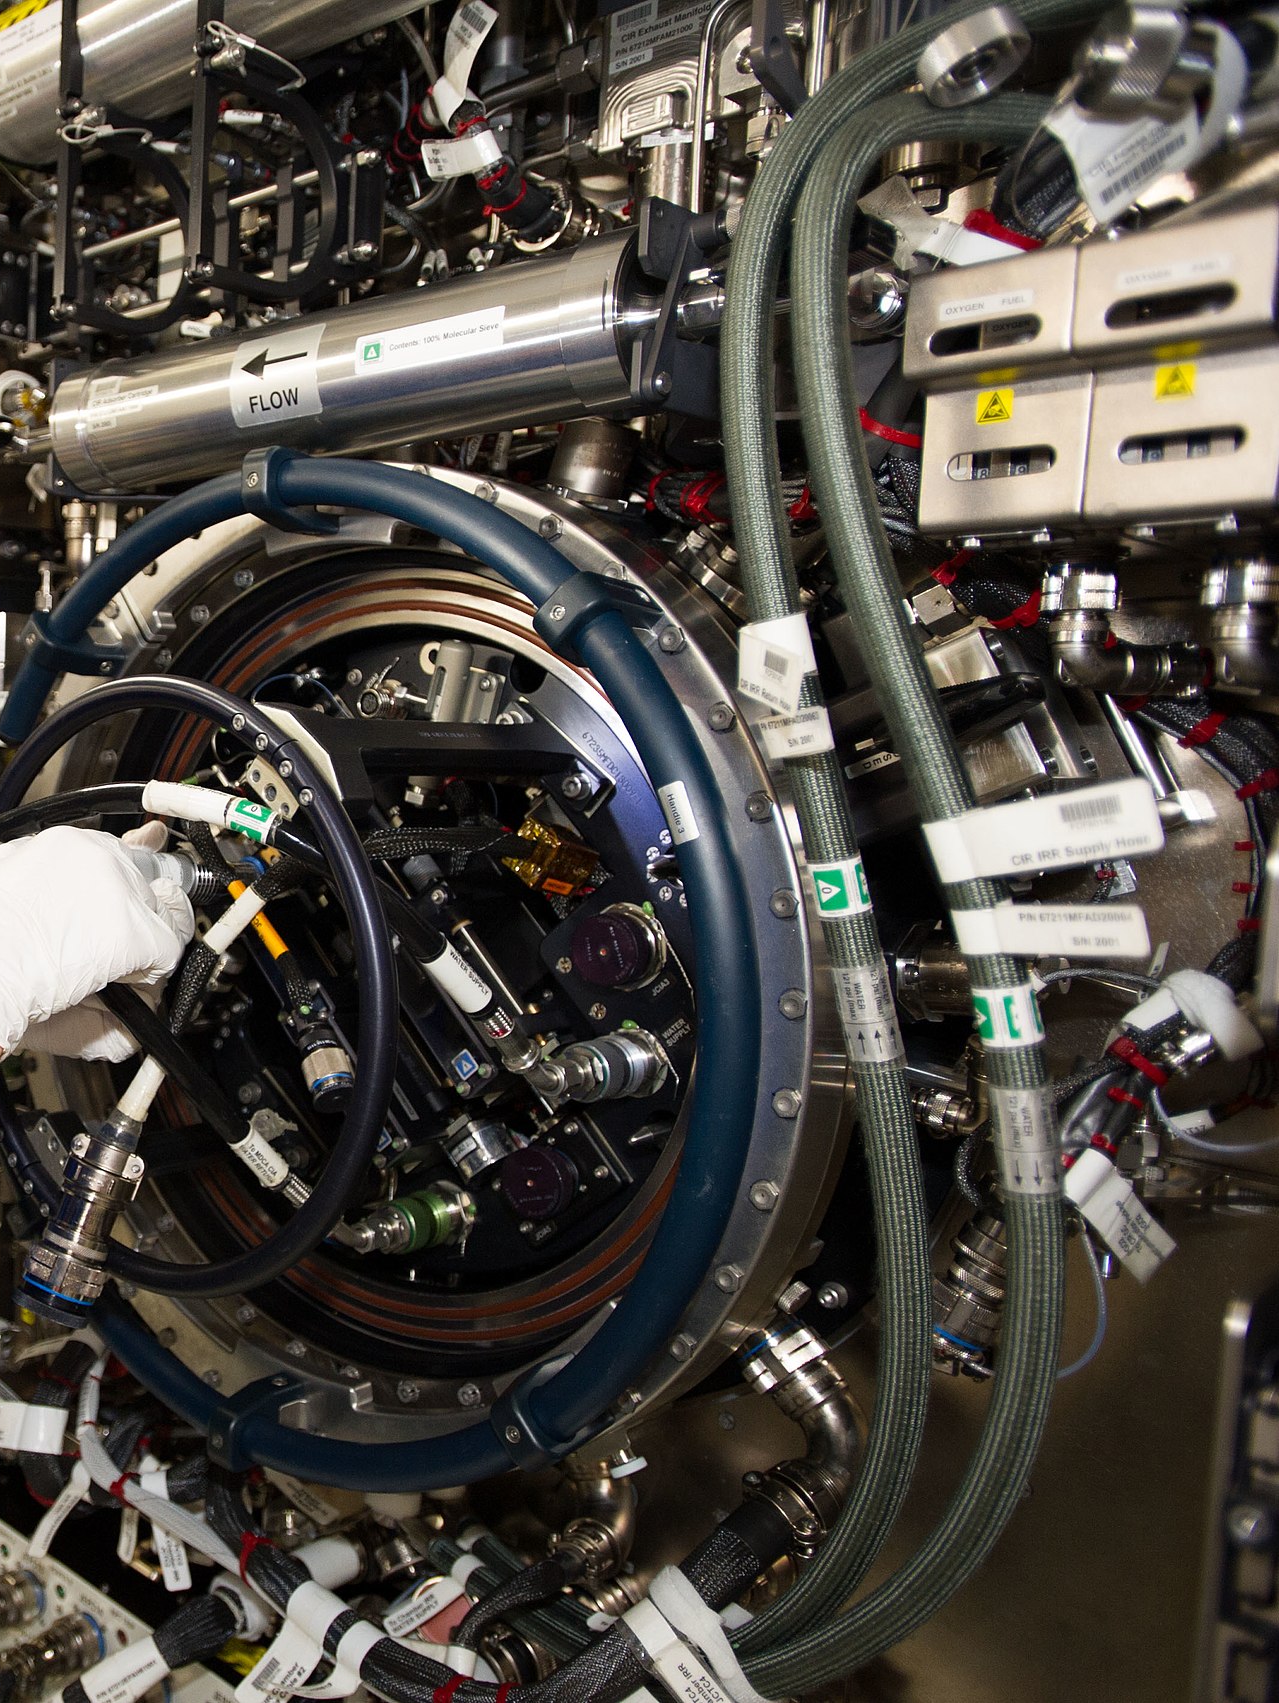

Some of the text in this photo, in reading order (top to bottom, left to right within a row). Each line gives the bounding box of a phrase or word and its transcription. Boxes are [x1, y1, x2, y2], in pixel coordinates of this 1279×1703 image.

[621, 32, 637, 43] CIR
[638, 20, 672, 37] Exhaust
[674, 2, 712, 24] Manifold
[945, 296, 1026, 316] OXYGEN FUEL
[389, 321, 499, 351] Contents: 100% Molecular Sieve
[992, 318, 1031, 333] OXYGEN
[249, 387, 299, 413] FLOW
[666, 793, 682, 826] Handle
[1011, 834, 1152, 866] CIR IRR Supply Hose
[450, 949, 489, 996] WATER SUPPLY
[842, 973, 858, 1021] 121 psi (max)
[853, 982, 866, 1010] WATER
[661, 1018, 692, 1047] WATER SUPPLY
[1021, 1106, 1034, 1137] WATER
[249, 1144, 278, 1177] To MDCA CIA
[392, 1600, 439, 1634] WATER SUPPLY
[398, 1603, 424, 1620] Chamber
[677, 1662, 695, 1680] IRR
